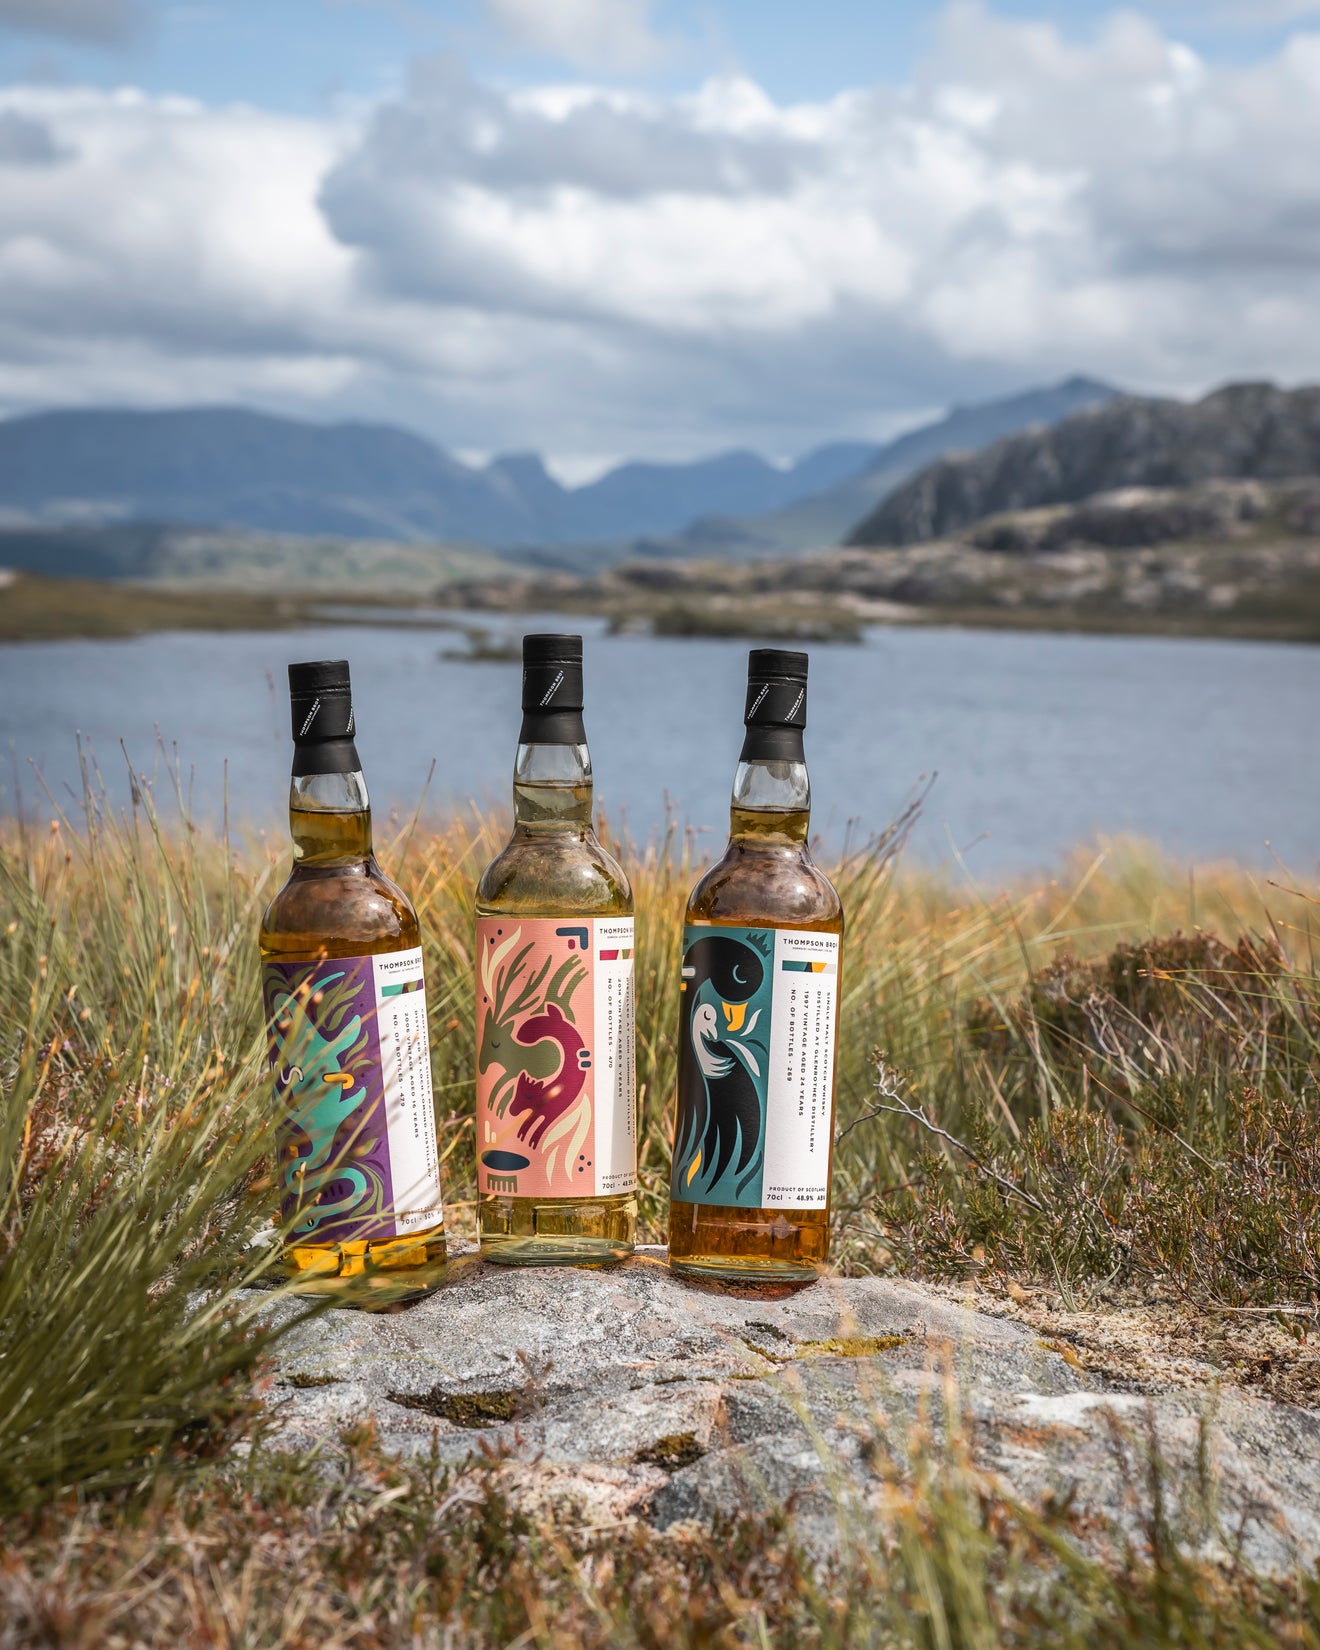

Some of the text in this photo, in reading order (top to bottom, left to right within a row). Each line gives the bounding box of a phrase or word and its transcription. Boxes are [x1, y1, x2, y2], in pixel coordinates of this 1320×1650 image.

[540, 682, 556, 706] THOMPSON
[748, 696, 761, 719] THOMPSON
[300, 712, 313, 736] THOMPSON
[783, 939, 823, 947] THOMPSON
[379, 960, 414, 970] THOMPSON
[608, 996, 612, 1006] OF
[790, 1007, 795, 1018] OF
[394, 1032, 400, 1042] OF
[815, 1036, 819, 1046] AT
[418, 1056, 422, 1064] AT
[801, 1077, 805, 1086] 24
